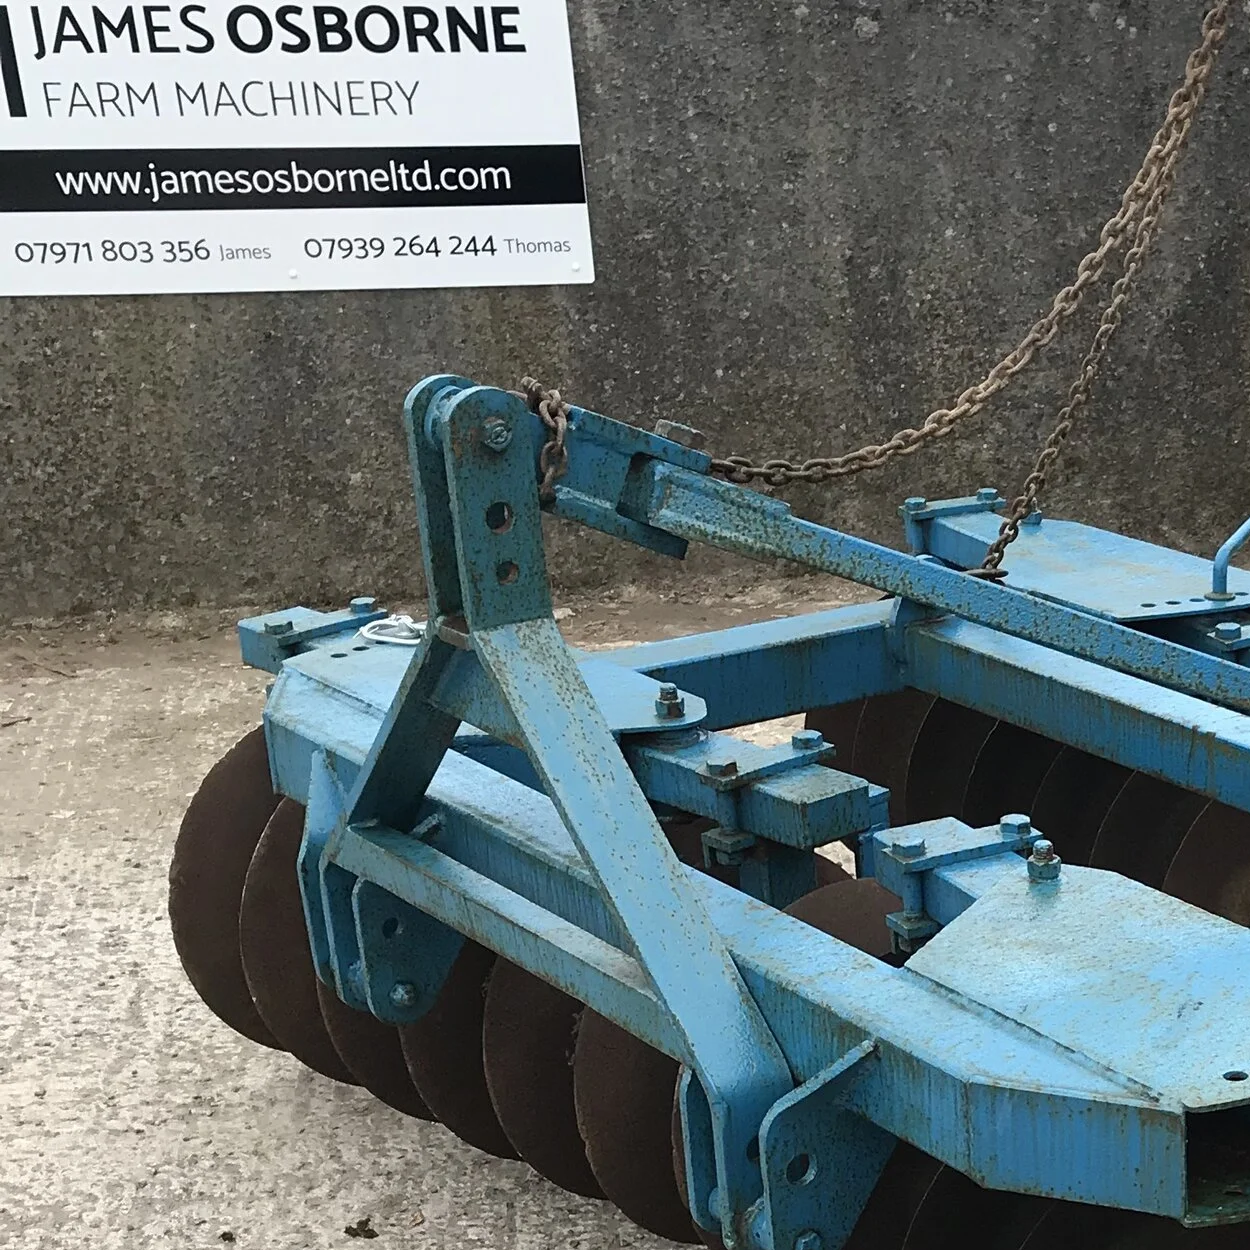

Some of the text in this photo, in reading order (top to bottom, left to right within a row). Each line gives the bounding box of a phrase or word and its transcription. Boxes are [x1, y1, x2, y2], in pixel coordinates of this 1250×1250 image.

[31, 5, 527, 60] JAMES OSBORNE
[42, 80, 420, 118] FARM MACHINERY
[55, 160, 512, 203] www.jamesosborneltd.com
[14, 234, 571, 264] 07971 803 356 James 07939 264 244 Thomas
